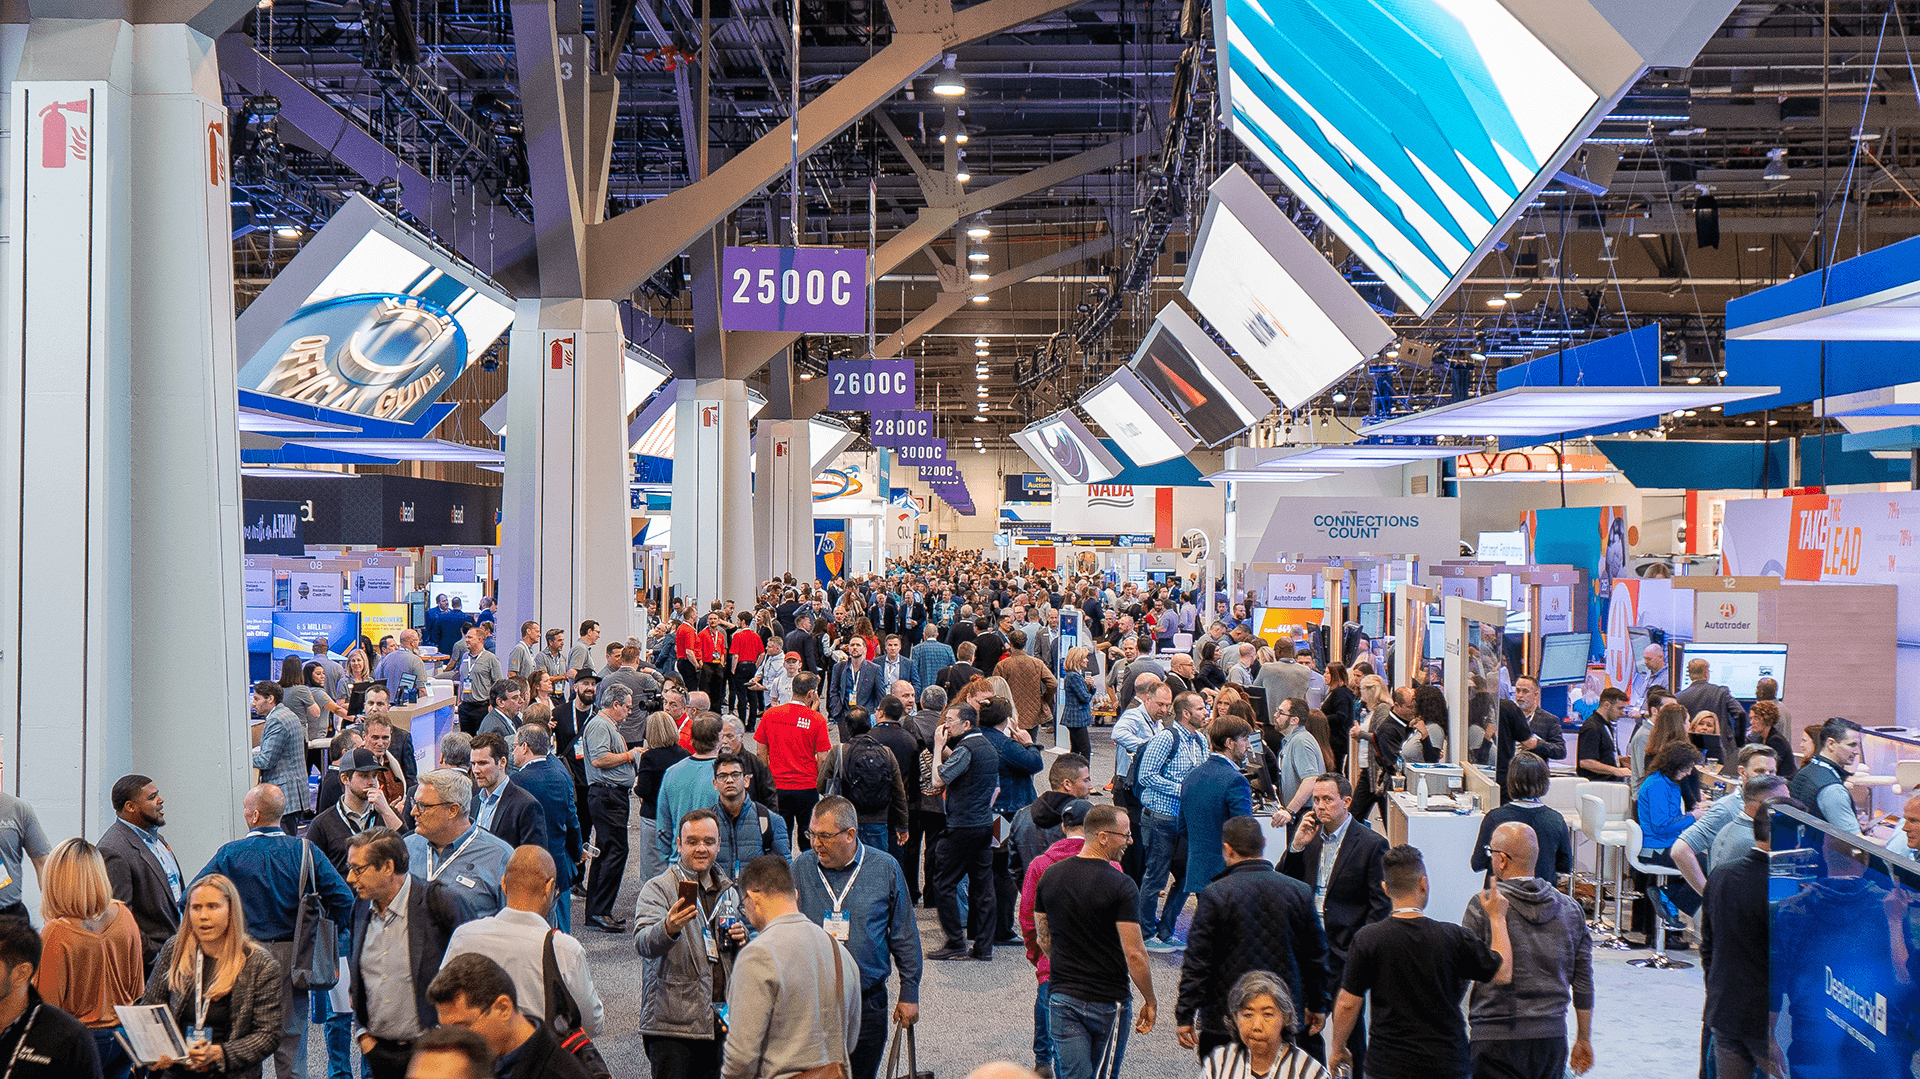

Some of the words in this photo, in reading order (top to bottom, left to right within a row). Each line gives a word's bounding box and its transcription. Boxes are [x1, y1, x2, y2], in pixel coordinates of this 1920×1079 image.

[559, 37, 572, 55] N
[560, 62, 573, 80] 3
[732, 268, 851, 306] 2500C
[373, 364, 446, 418] GUIDE
[833, 371, 907, 395] 2600C
[875, 419, 927, 436] 2800C
[901, 446, 942, 459] 3000C
[920, 465, 953, 477] 3200C
[1088, 484, 1134, 497] NADA
[400, 501, 415, 522] elead
[451, 505, 464, 524] elead
[1830, 498, 1843, 522] THE
[1313, 515, 1420, 527] CONNECTIONS
[1328, 527, 1380, 539] COUNT
[1798, 509, 1828, 551] TAKE
[1824, 526, 1862, 576] LEAD
[309, 560, 323, 570] 08
[367, 557, 379, 566] 02
[1285, 564, 1296, 572] 02
[1454, 566, 1465, 576] 06
[1723, 577, 1736, 589] 12
[1704, 621, 1751, 630] Autotrader
[1825, 965, 1877, 1029] Dealertrack
